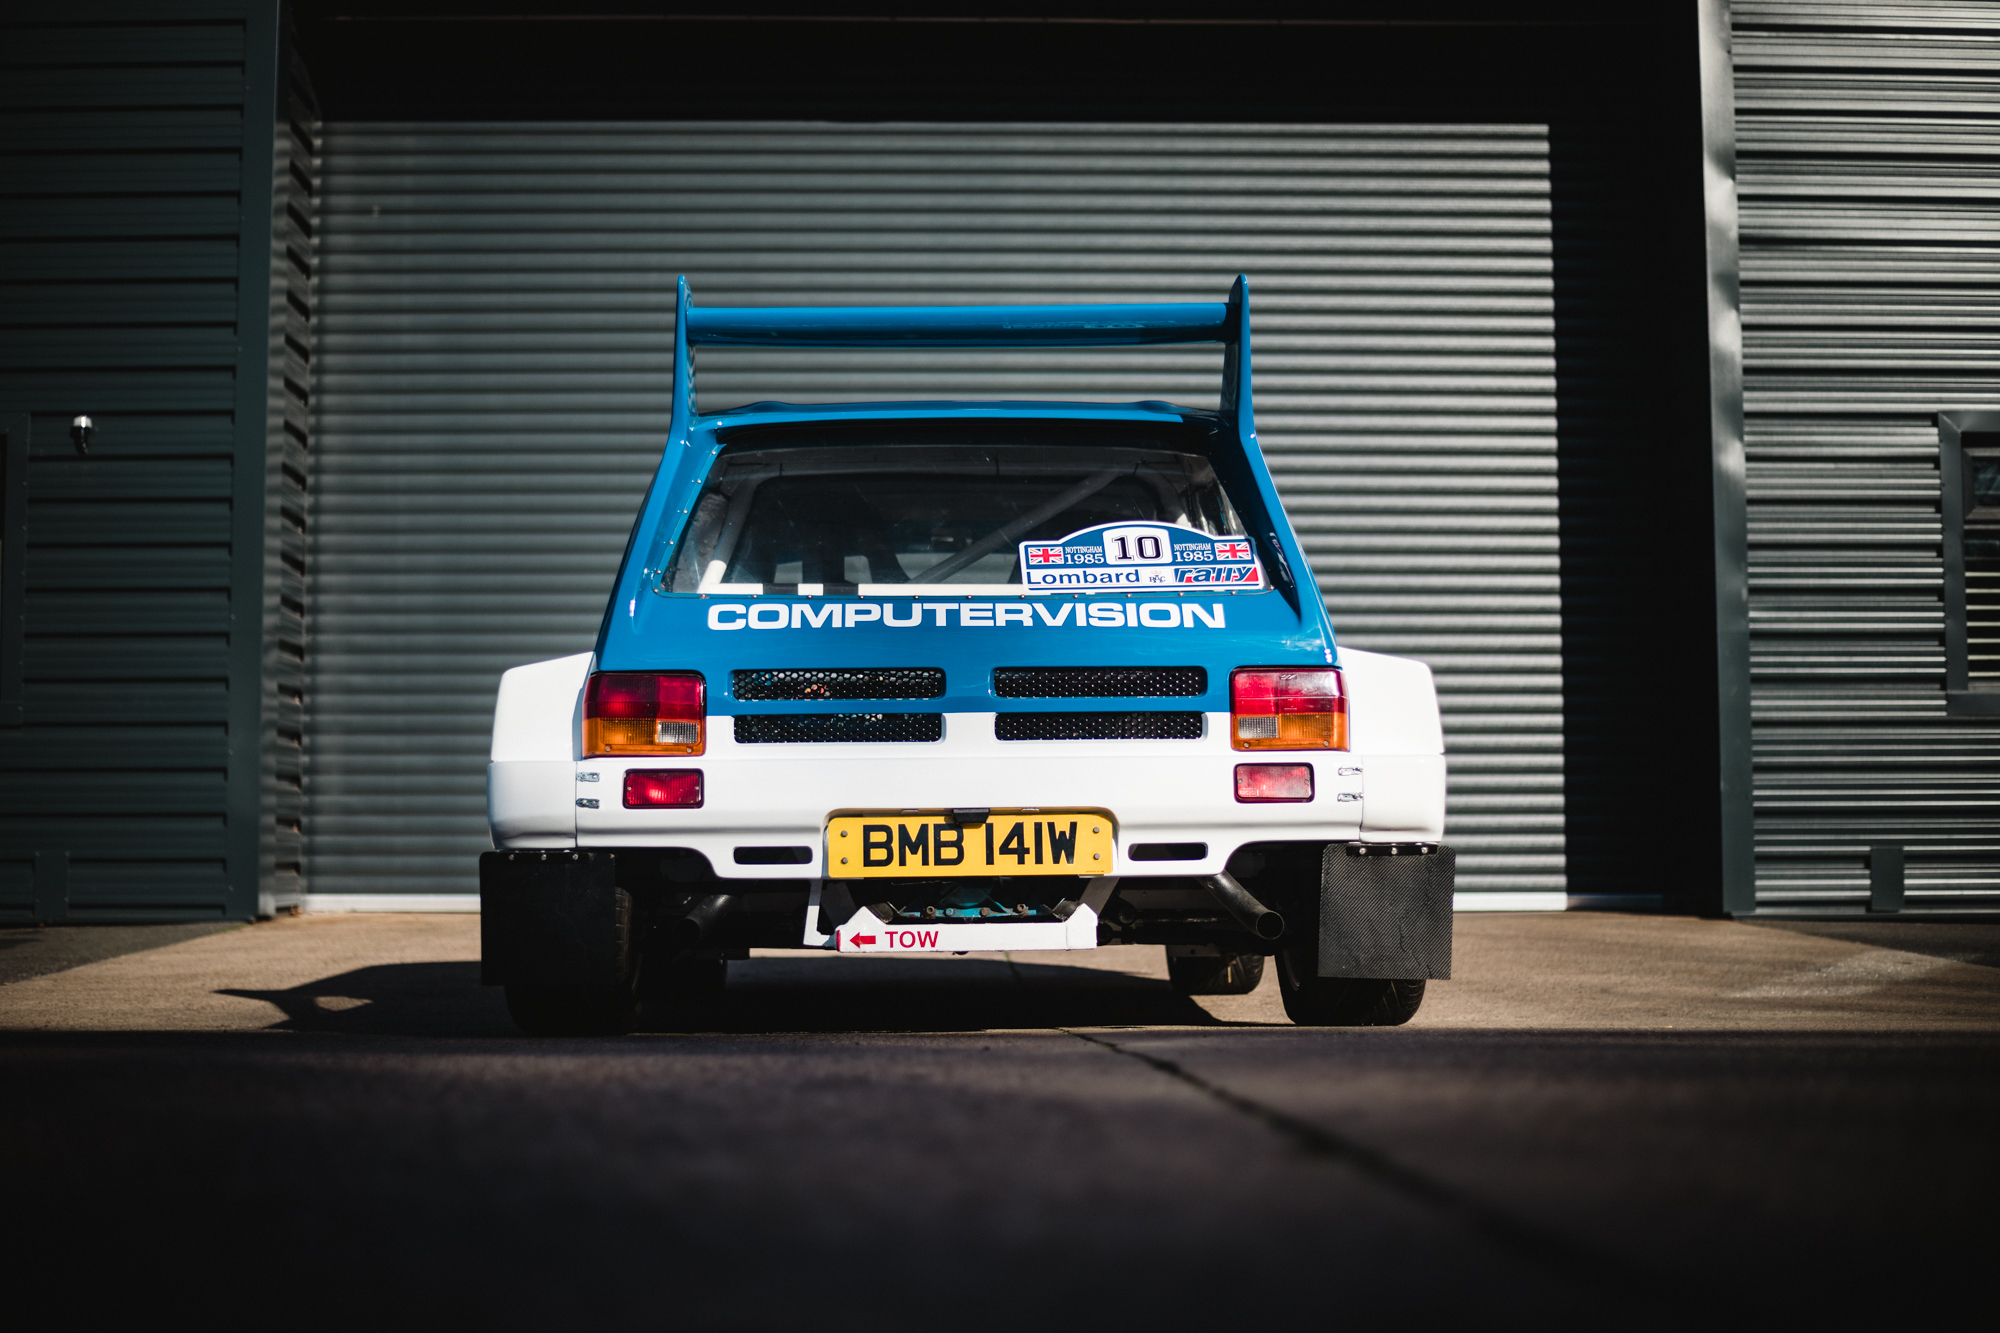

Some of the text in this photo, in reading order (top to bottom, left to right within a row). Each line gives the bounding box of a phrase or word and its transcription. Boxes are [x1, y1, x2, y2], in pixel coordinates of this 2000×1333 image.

[1065, 546, 1103, 554] NOTTINGHAM
[1111, 534, 1163, 562] 10
[1174, 543, 1211, 551] NOTTINGHAM
[1065, 553, 1104, 565] 1985
[1174, 551, 1214, 562] 1985
[1027, 569, 1140, 585] Lombard
[1176, 567, 1255, 583] rally
[707, 602, 1226, 630] COMPUTERVISION
[862, 821, 1078, 867] BMB 141W
[885, 930, 939, 948] TOW
